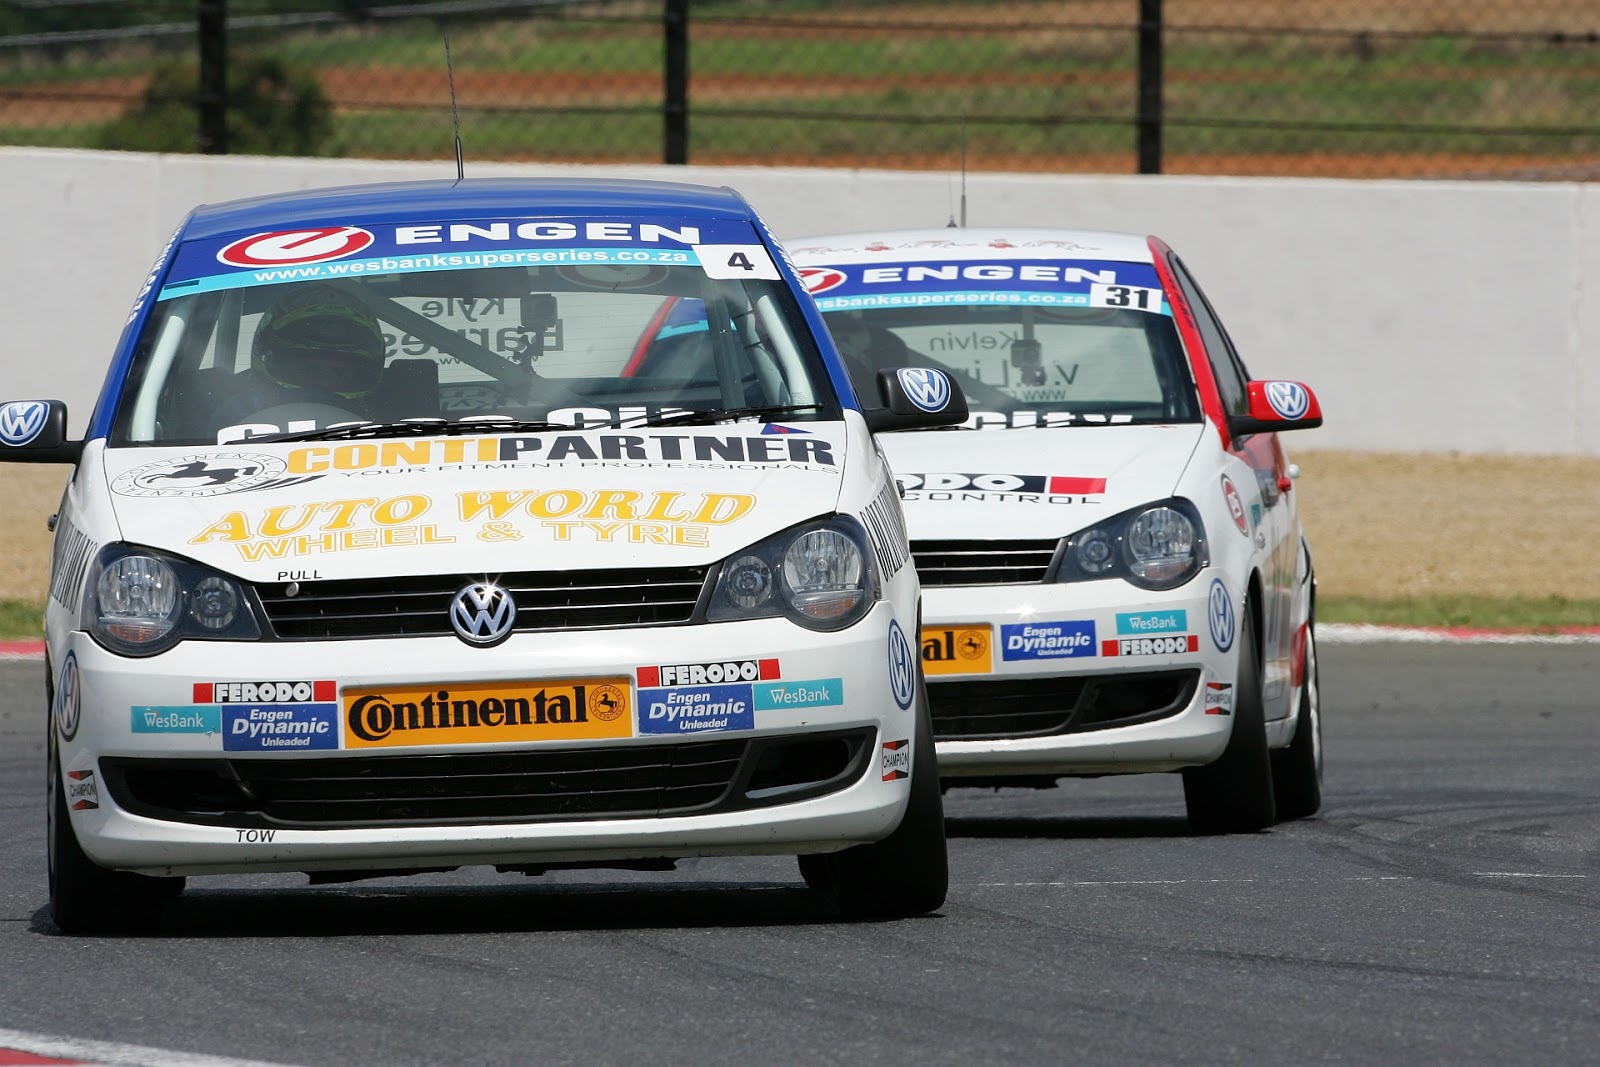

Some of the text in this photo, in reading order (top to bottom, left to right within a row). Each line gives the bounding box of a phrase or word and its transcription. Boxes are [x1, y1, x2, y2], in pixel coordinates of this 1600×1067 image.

[394, 222, 700, 246] ENGEN
[254, 247, 688, 282] www.wesbanksuperseries.co.za
[726, 251, 755, 271] 4
[862, 265, 1116, 284] ENGEN
[1105, 286, 1150, 309] 31
[287, 434, 836, 475] CONTIPARTNER
[340, 462, 839, 477] YOUR FITMENT PROFESSIONALS
[186, 488, 757, 545] AUTO WORLD
[236, 521, 710, 563] WHEEL & TYRE
[277, 570, 323, 582] PULL
[1023, 626, 1062, 638] Engen
[1129, 616, 1177, 630] WesBank
[1007, 632, 1091, 652] Dynamic
[1120, 637, 1187, 656] FERODO
[661, 661, 757, 685] FERODO
[216, 683, 311, 702] FERODO
[667, 692, 710, 705] Engen
[770, 686, 830, 704] WesBank
[143, 708, 204, 728] WesBank
[249, 708, 293, 722] Engen
[348, 685, 589, 742] Continental
[648, 698, 746, 721] Dynamic
[231, 717, 330, 737] Dynamic
[679, 717, 728, 731] Unleaded
[261, 736, 311, 747] Unleaded
[70, 783, 96, 799] CHAMPION
[235, 829, 276, 844] TOW
